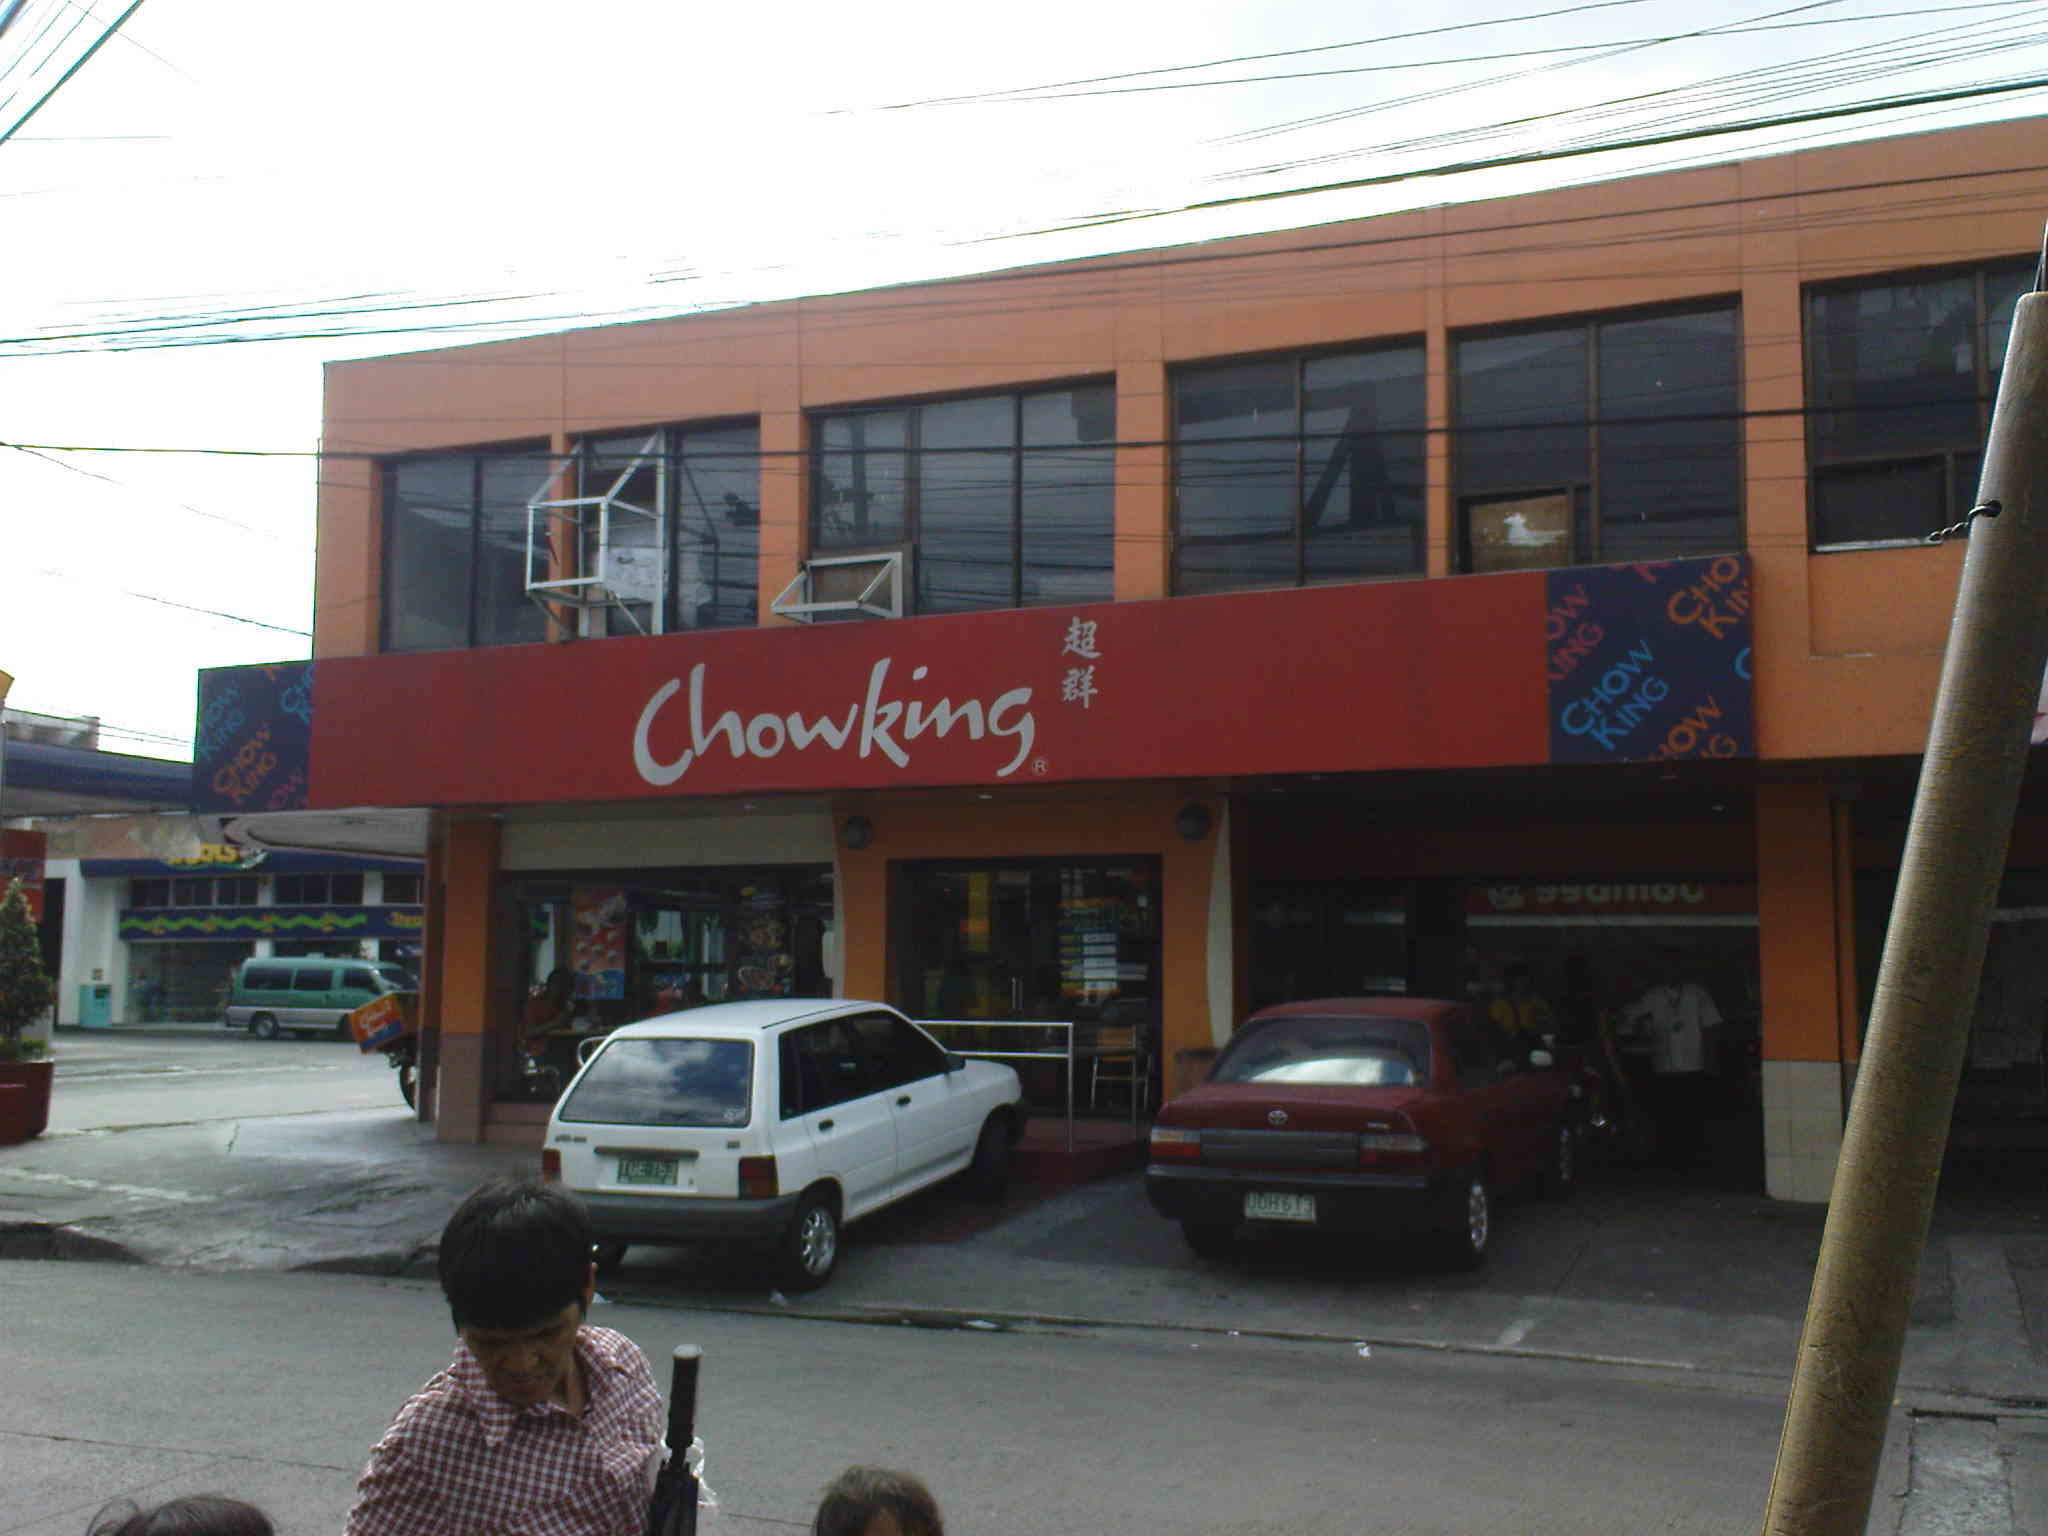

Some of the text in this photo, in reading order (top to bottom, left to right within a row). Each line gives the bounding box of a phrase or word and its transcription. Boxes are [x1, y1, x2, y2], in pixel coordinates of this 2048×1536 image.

[1667, 557, 1741, 624] CHO
[1062, 616, 1102, 709] 超群
[1560, 640, 1654, 735] CHOW
[633, 657, 1036, 786] Chowking
[1591, 676, 1669, 751] KING
